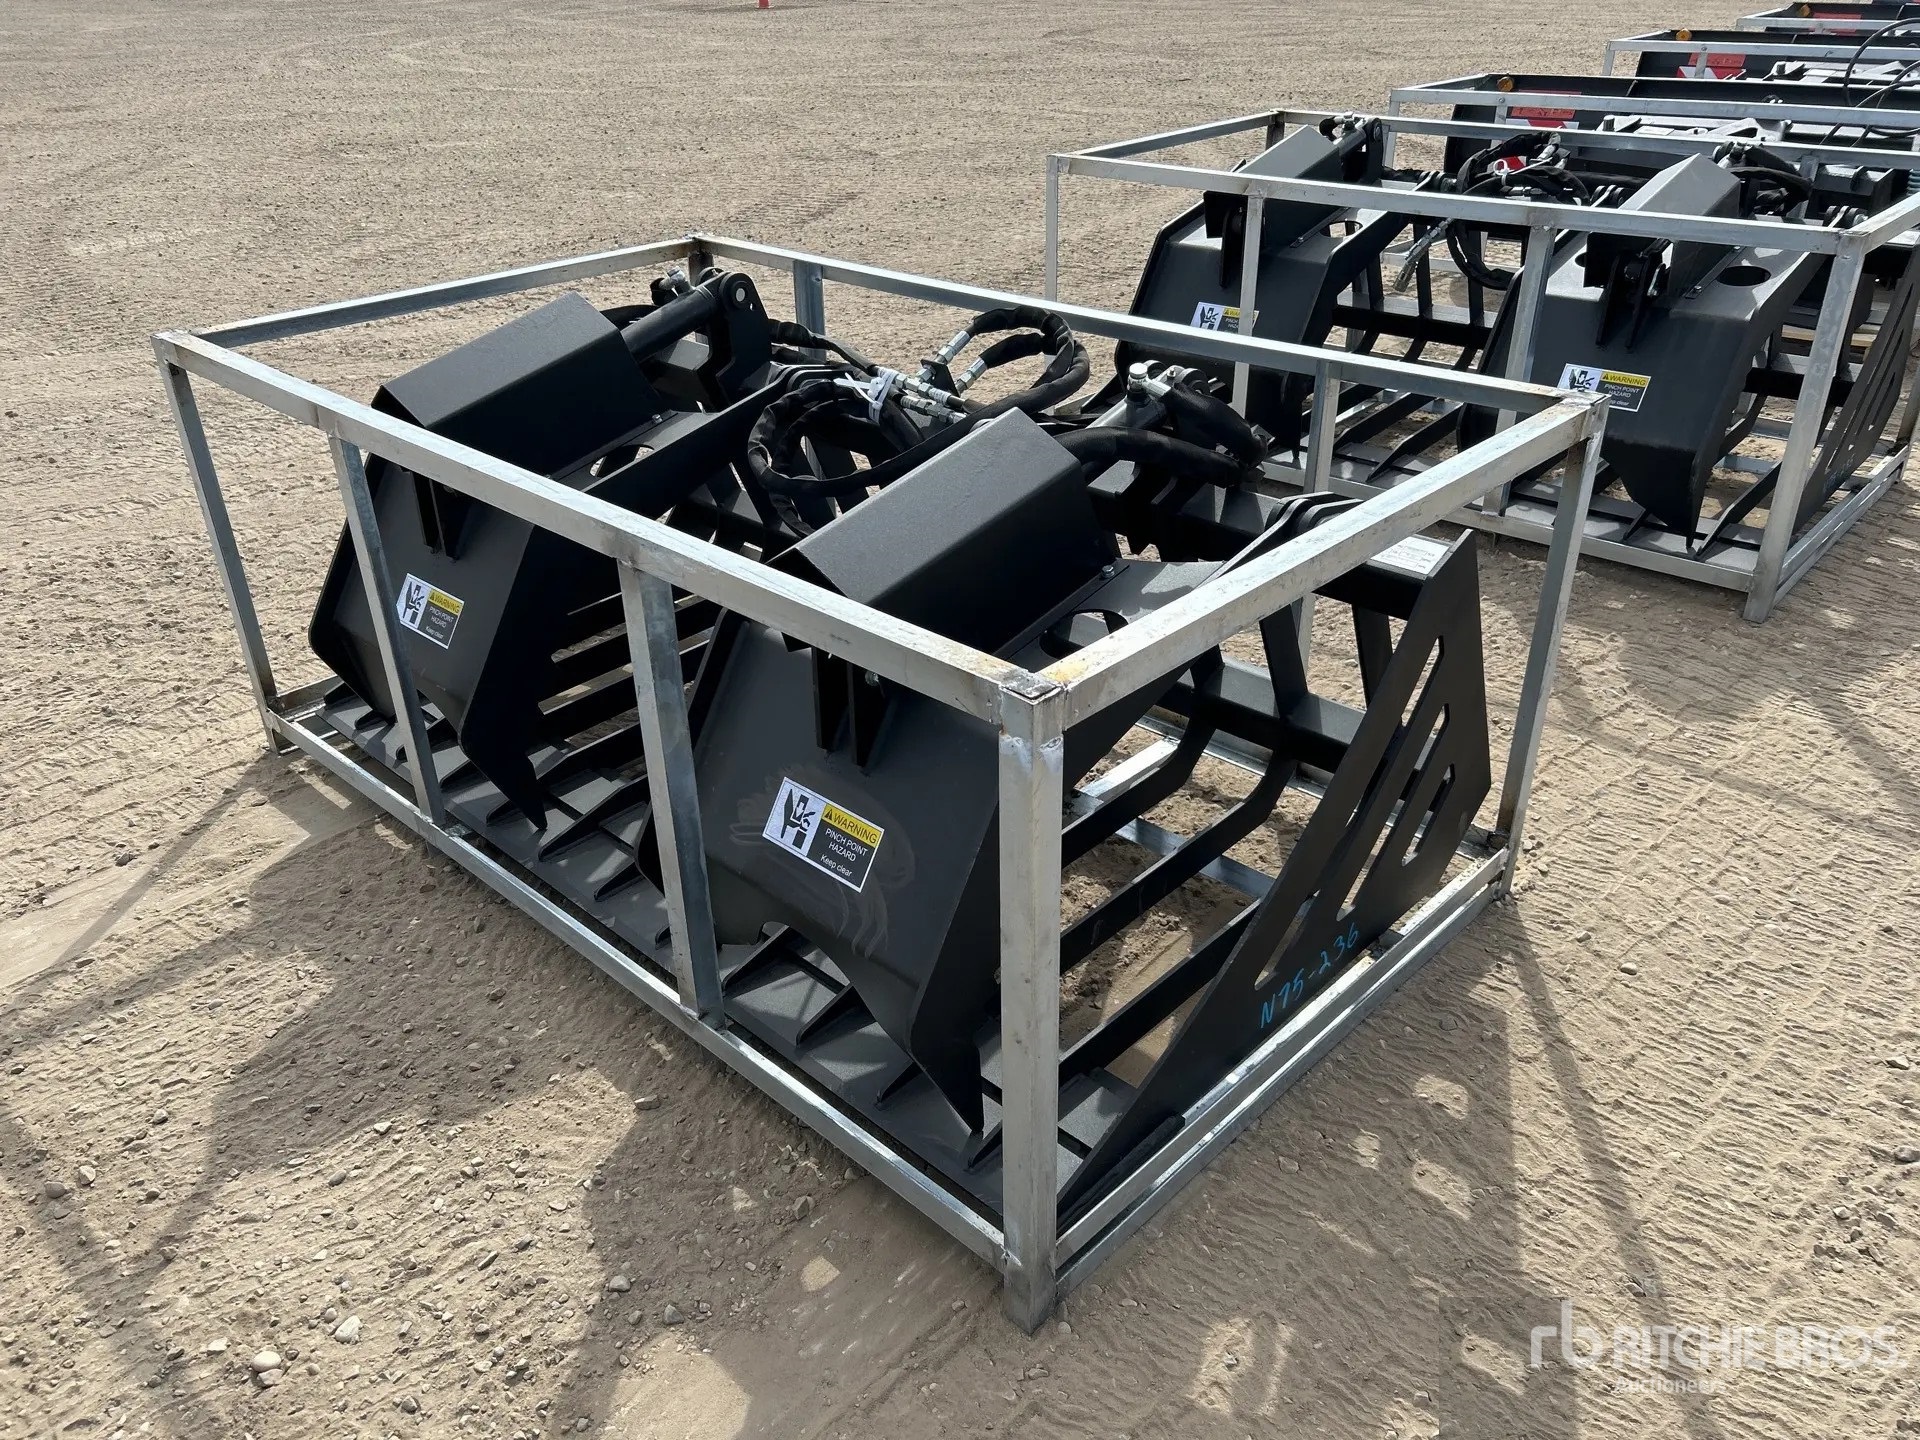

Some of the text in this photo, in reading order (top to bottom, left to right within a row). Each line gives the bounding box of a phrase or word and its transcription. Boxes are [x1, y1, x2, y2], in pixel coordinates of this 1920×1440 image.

[1609, 375, 1646, 385] WARNING
[1609, 390, 1632, 398] HAZARD
[434, 594, 460, 613] WARNING
[429, 606, 454, 622] PINCH POINT
[431, 616, 447, 628] HAZARD
[834, 812, 878, 844] WARNING
[825, 828, 868, 857] PINCH POINT
[828, 842, 857, 862] HAZARD
[820, 854, 852, 876] Keep clear
